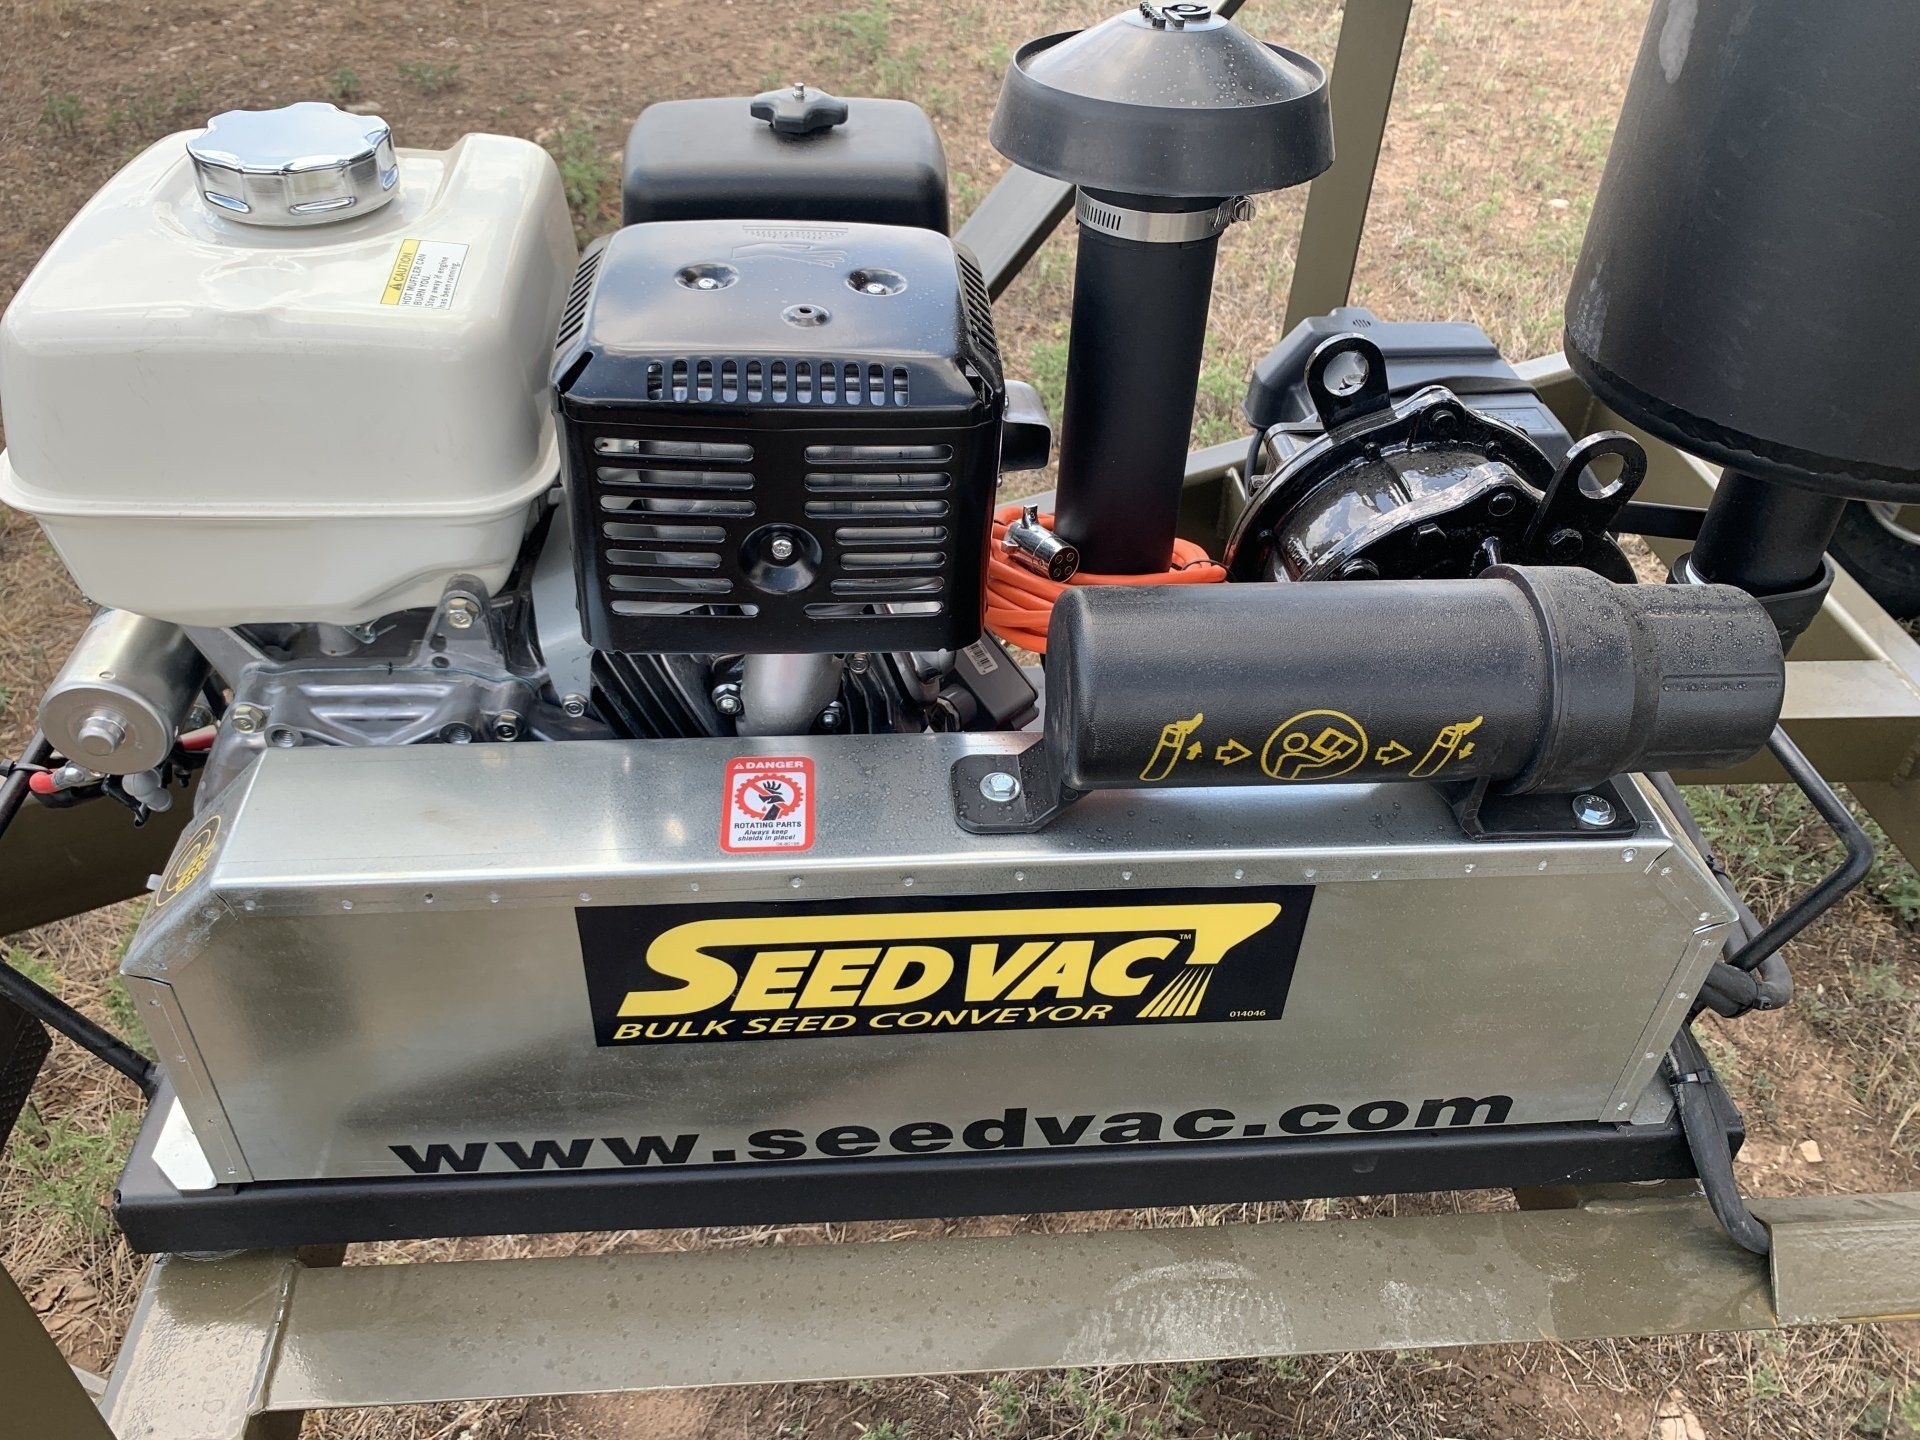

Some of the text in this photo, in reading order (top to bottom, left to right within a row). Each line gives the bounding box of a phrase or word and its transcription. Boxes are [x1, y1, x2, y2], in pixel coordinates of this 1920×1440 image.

[394, 252, 413, 282] CAUTION
[402, 253, 426, 304] HOT MUFFLER CAN
[425, 294, 438, 307] Stay
[432, 280, 443, 293] away
[438, 257, 449, 274] engine
[414, 289, 425, 305] BURN
[441, 283, 450, 297] been
[437, 298, 448, 308] has
[745, 760, 804, 769] DANGER
[734, 821, 774, 829] ROTATING
[737, 834, 763, 842] shields
[1229, 1009, 1267, 1018] 014046
[612, 1004, 1114, 1041] BULK SEED CONVEYOR
[387, 1094, 1514, 1174] www.seedvac.com
